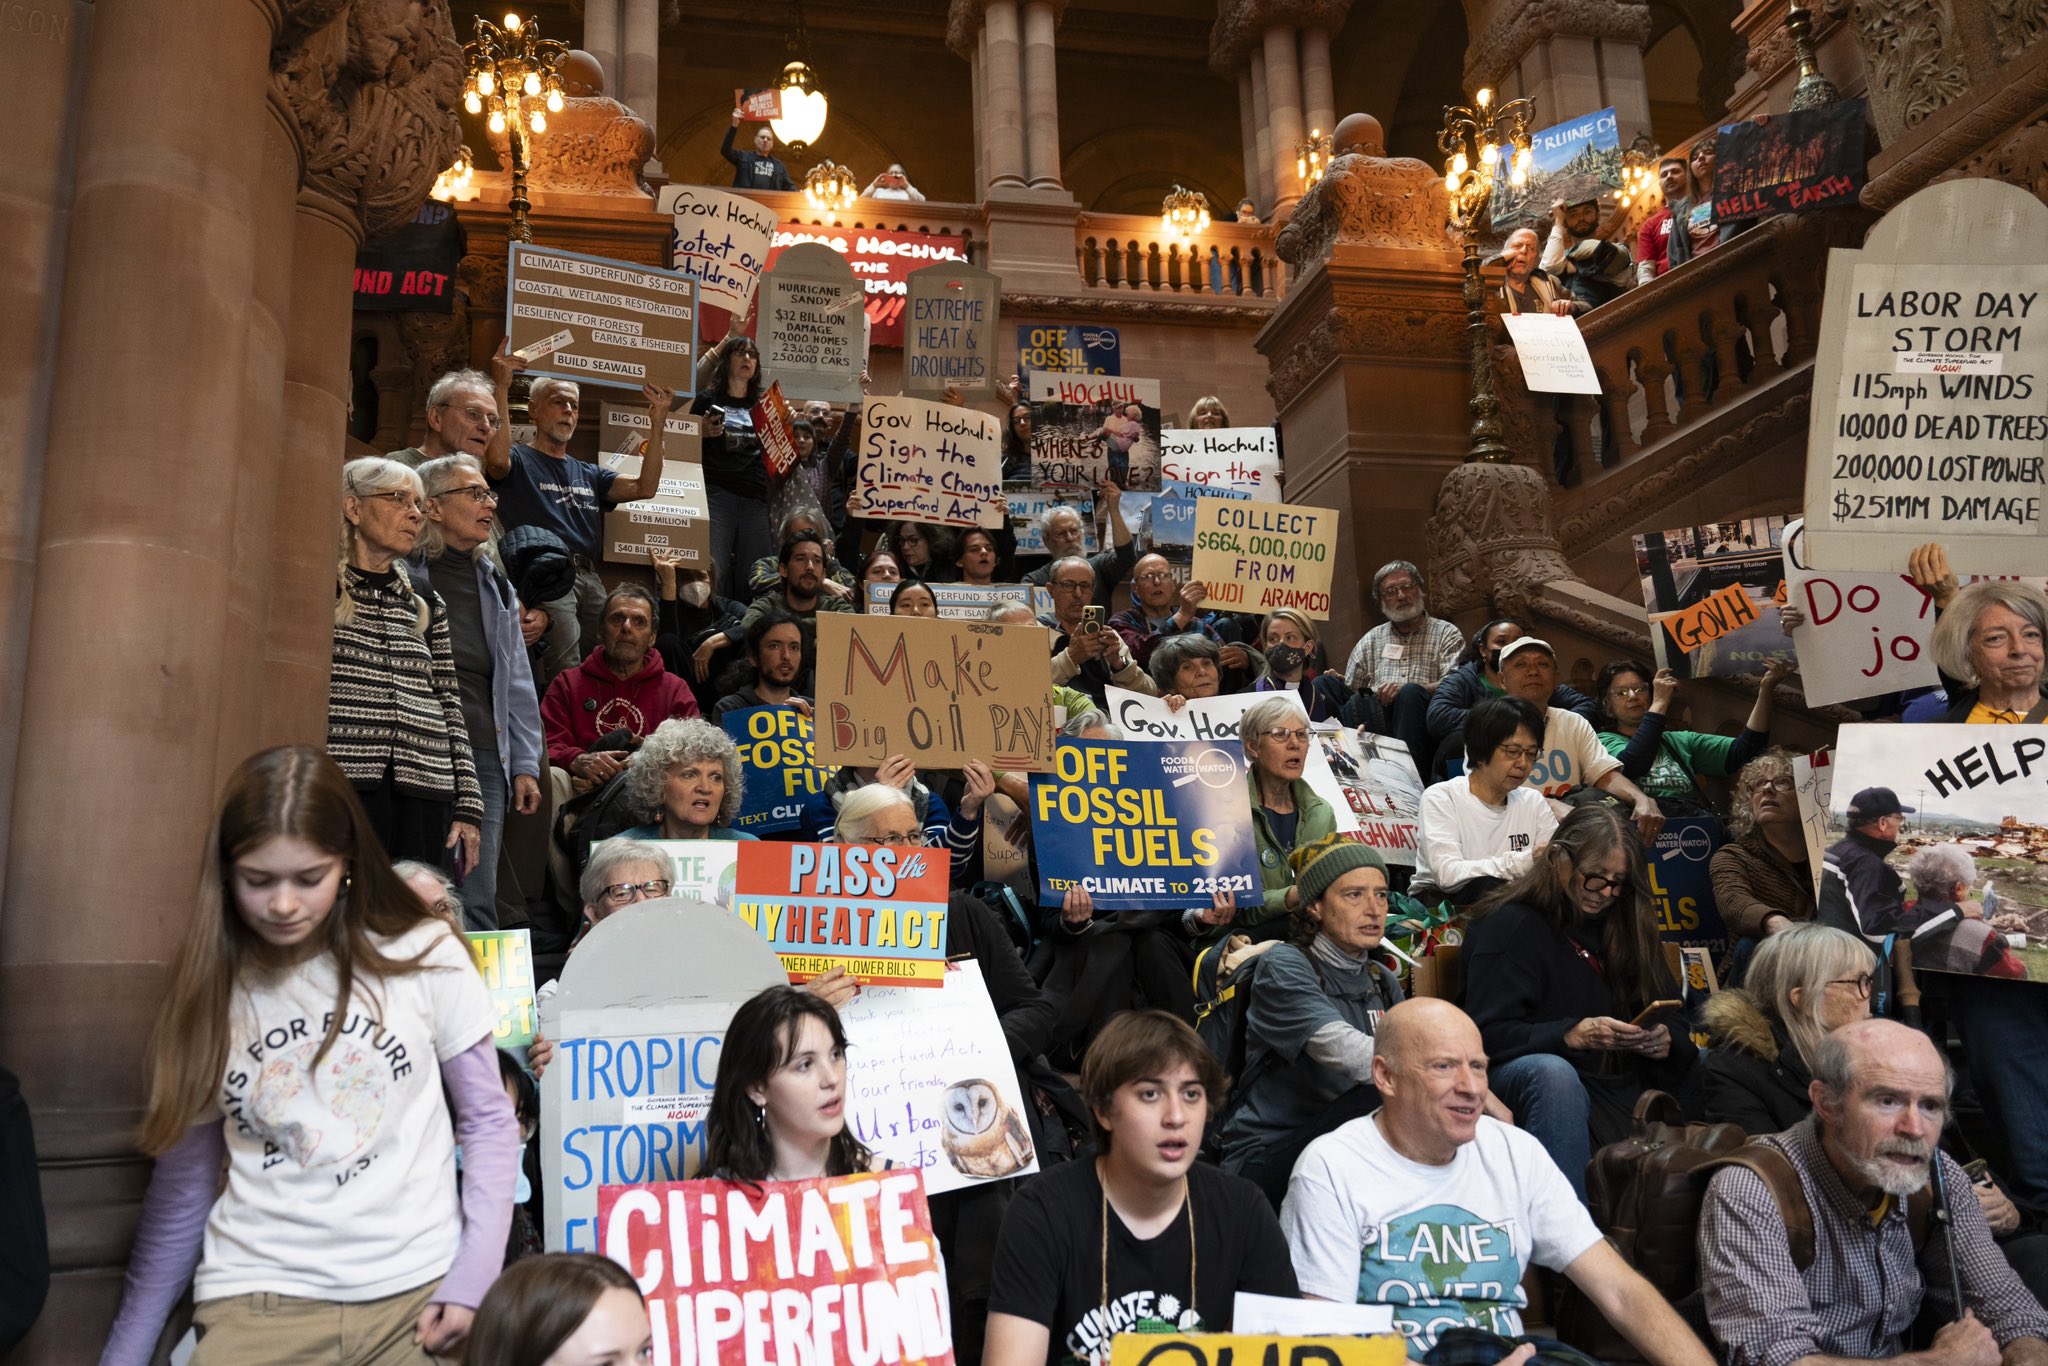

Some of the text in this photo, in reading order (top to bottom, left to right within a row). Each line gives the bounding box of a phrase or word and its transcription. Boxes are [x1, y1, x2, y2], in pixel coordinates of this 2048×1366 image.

[749, 100, 774, 113] BUSINESS
[1715, 191, 1769, 218] HELL
[1776, 181, 1802, 197] ON
[1789, 175, 1854, 209] EARTH
[672, 191, 775, 241] Gov. Hochul:
[524, 255, 688, 294] CLIMATE SUPERFUND $$ FOR:
[851, 261, 889, 273] THE
[400, 271, 449, 296] ACT
[778, 282, 841, 297] HURRICANE
[518, 281, 689, 318] COASTAL WETLANDS RESTORATION
[790, 294, 831, 306] SANDY
[914, 298, 983, 323] EXTREME
[1857, 290, 2038, 319] LABOR DAY
[517, 305, 640, 334] RESILIENCY FOR FORESTS
[774, 308, 846, 326] $32 BILLION
[786, 322, 833, 335] DAMAGE
[594, 331, 686, 354] FARMS & FISHERIES
[772, 331, 848, 346] 70,000 HOMES
[918, 326, 977, 350] HEAT &
[1030, 328, 1068, 348] OFF
[1892, 325, 2022, 352] STORM
[772, 352, 850, 367] 250,000 CARS
[824, 346, 843, 356] BIZ
[1021, 347, 1088, 367] FOSSIL
[557, 354, 643, 376] BUILD SEAWALLS
[911, 354, 985, 377] DROUGHTS
[1933, 364, 1963, 373] NOW!
[1059, 379, 1143, 406] HOCHUL
[1852, 373, 2035, 410] 115mph WINDS
[611, 412, 694, 433] BIG OIL UP:
[759, 392, 798, 466] EMERGENCY
[867, 402, 993, 441] Gov Hochul:
[1839, 412, 2048, 442] 10,000 DEAD TREES
[757, 423, 788, 474] CLIMATE
[866, 432, 976, 467] Sign the
[1203, 436, 1275, 454] Hochul:
[859, 462, 1000, 502] Climate Change
[1040, 462, 1091, 485] YOUR
[1162, 461, 1261, 486] Sign the
[1832, 454, 2046, 485] 200,000 LOST POWER
[679, 480, 700, 489] TONS
[629, 502, 697, 516] PAY SUPERFUND
[862, 486, 982, 521] Superfund Act
[1832, 488, 2040, 525] $251MM DAMAGE
[633, 513, 688, 527] $198 MILLION
[1217, 507, 1317, 536] COLLECT
[617, 543, 633, 554] $40
[647, 535, 668, 544] 2022
[1197, 531, 1326, 562] $664,000,000
[1235, 559, 1295, 584] FROM
[1709, 561, 1768, 572] Broadway Station
[987, 592, 1024, 602] $$ FOR:
[1260, 587, 1330, 612] ARAMCO
[1804, 578, 1880, 626] Do
[938, 608, 960, 617] HEAT
[844, 627, 999, 704] Make
[748, 710, 814, 740] OFF
[830, 690, 965, 761] Big Oil
[1119, 699, 1186, 740] Gov.
[1056, 745, 1195, 785] OFF FOOD&
[1036, 763, 1234, 827] FOSSIL WATER WATCH
[1798, 774, 1817, 794] Dear
[738, 812, 769, 826] TEXT
[1092, 828, 1220, 867] FUELS
[1655, 839, 1708, 849] WATER WATCH
[789, 844, 928, 898] PASS the
[1048, 874, 1254, 894] TEXT CLIMATE TO 23321
[785, 905, 946, 950] HEAT ACT
[809, 958, 916, 977] HEAT LOWER BILLS
[247, 1018, 310, 1063] FOR
[899, 1067, 948, 1091] friends,
[667, 1109, 699, 1120] NOW!
[855, 1100, 941, 1143] Urban
[562, 1120, 709, 1191] STORM
[1361, 1217, 1517, 1265] PLANET
[649, 1269, 955, 1366] UPERFUND
[1066, 1290, 1156, 1355] CLIMATE
